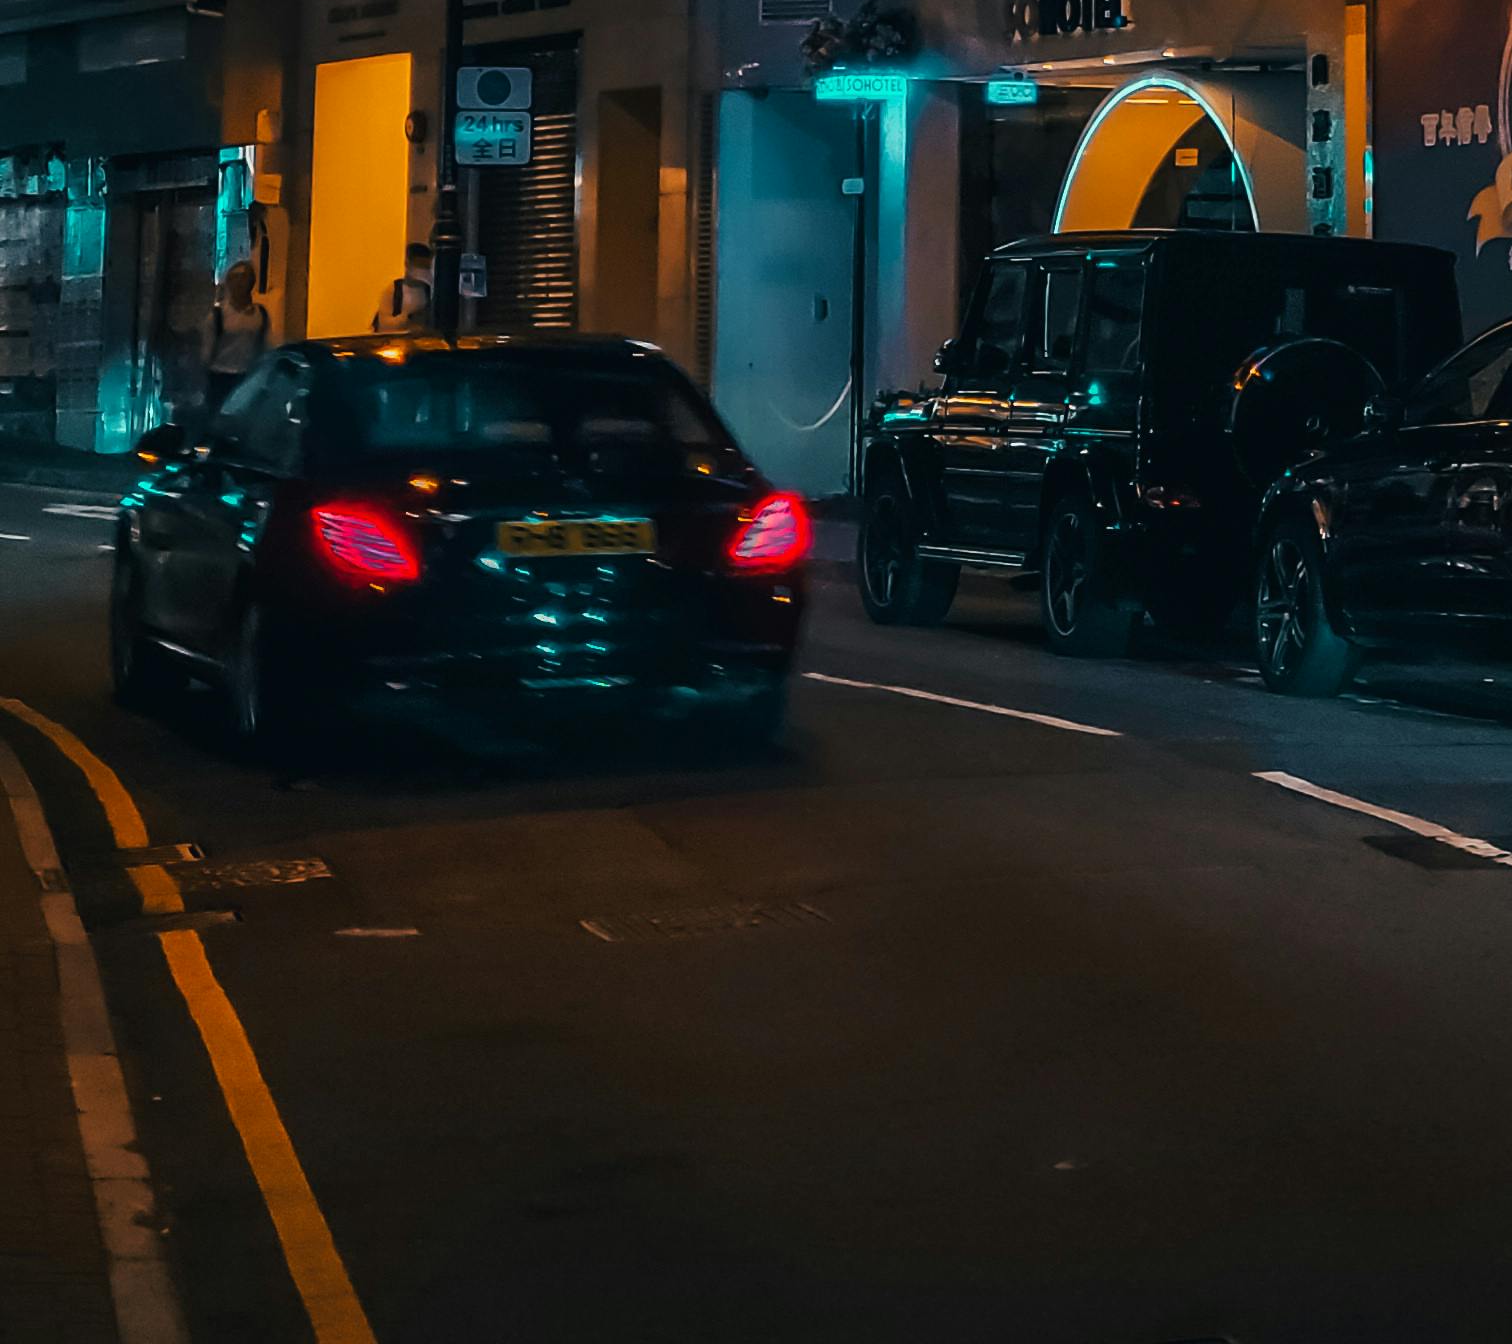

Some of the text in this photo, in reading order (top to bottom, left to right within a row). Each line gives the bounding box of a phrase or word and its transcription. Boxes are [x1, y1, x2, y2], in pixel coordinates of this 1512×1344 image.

[464, 115, 524, 133] 24 hrs
[472, 138, 517, 160] 全日
